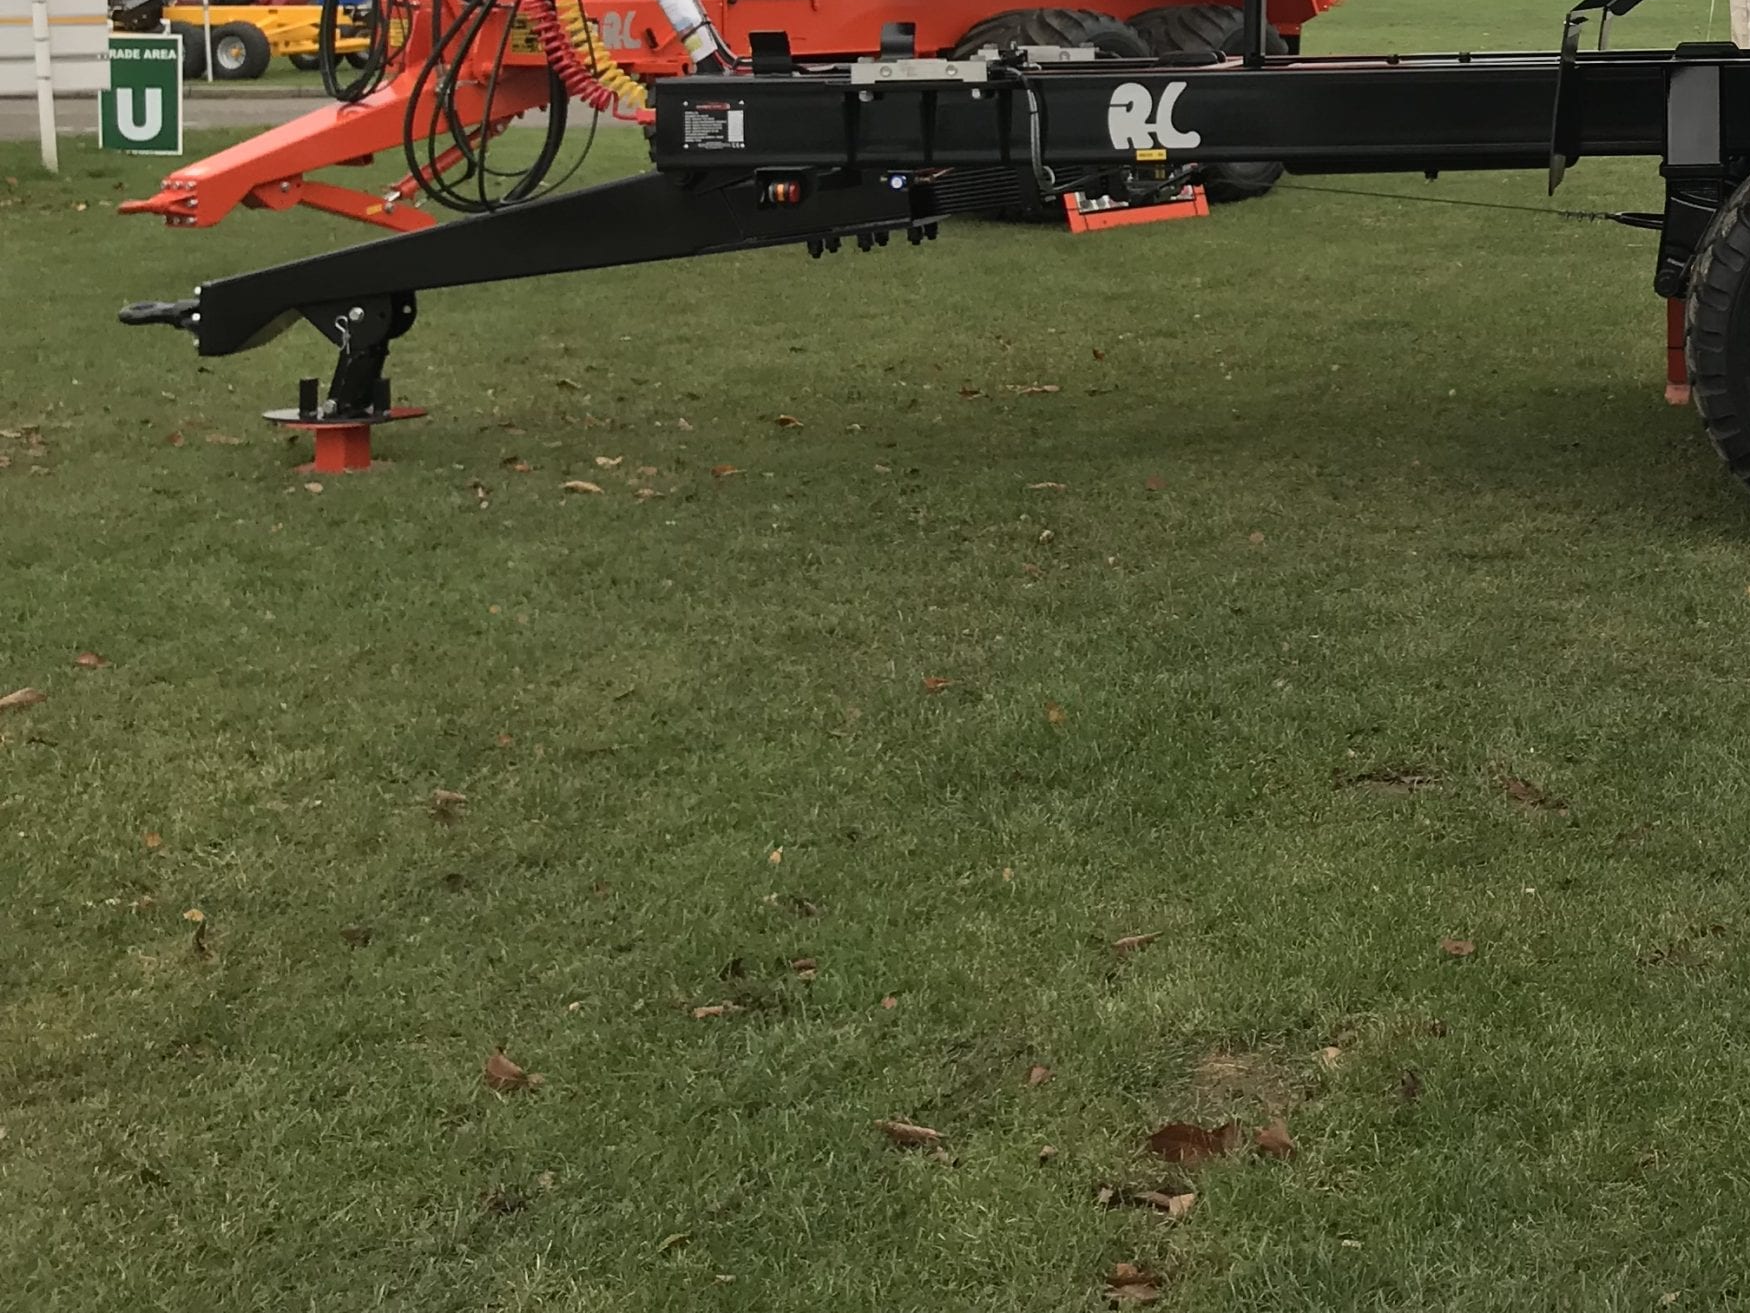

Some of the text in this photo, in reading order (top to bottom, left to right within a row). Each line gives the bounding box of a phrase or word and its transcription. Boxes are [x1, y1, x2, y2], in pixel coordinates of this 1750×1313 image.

[108, 48, 177, 60] RADE AREA
[116, 87, 163, 141] U
